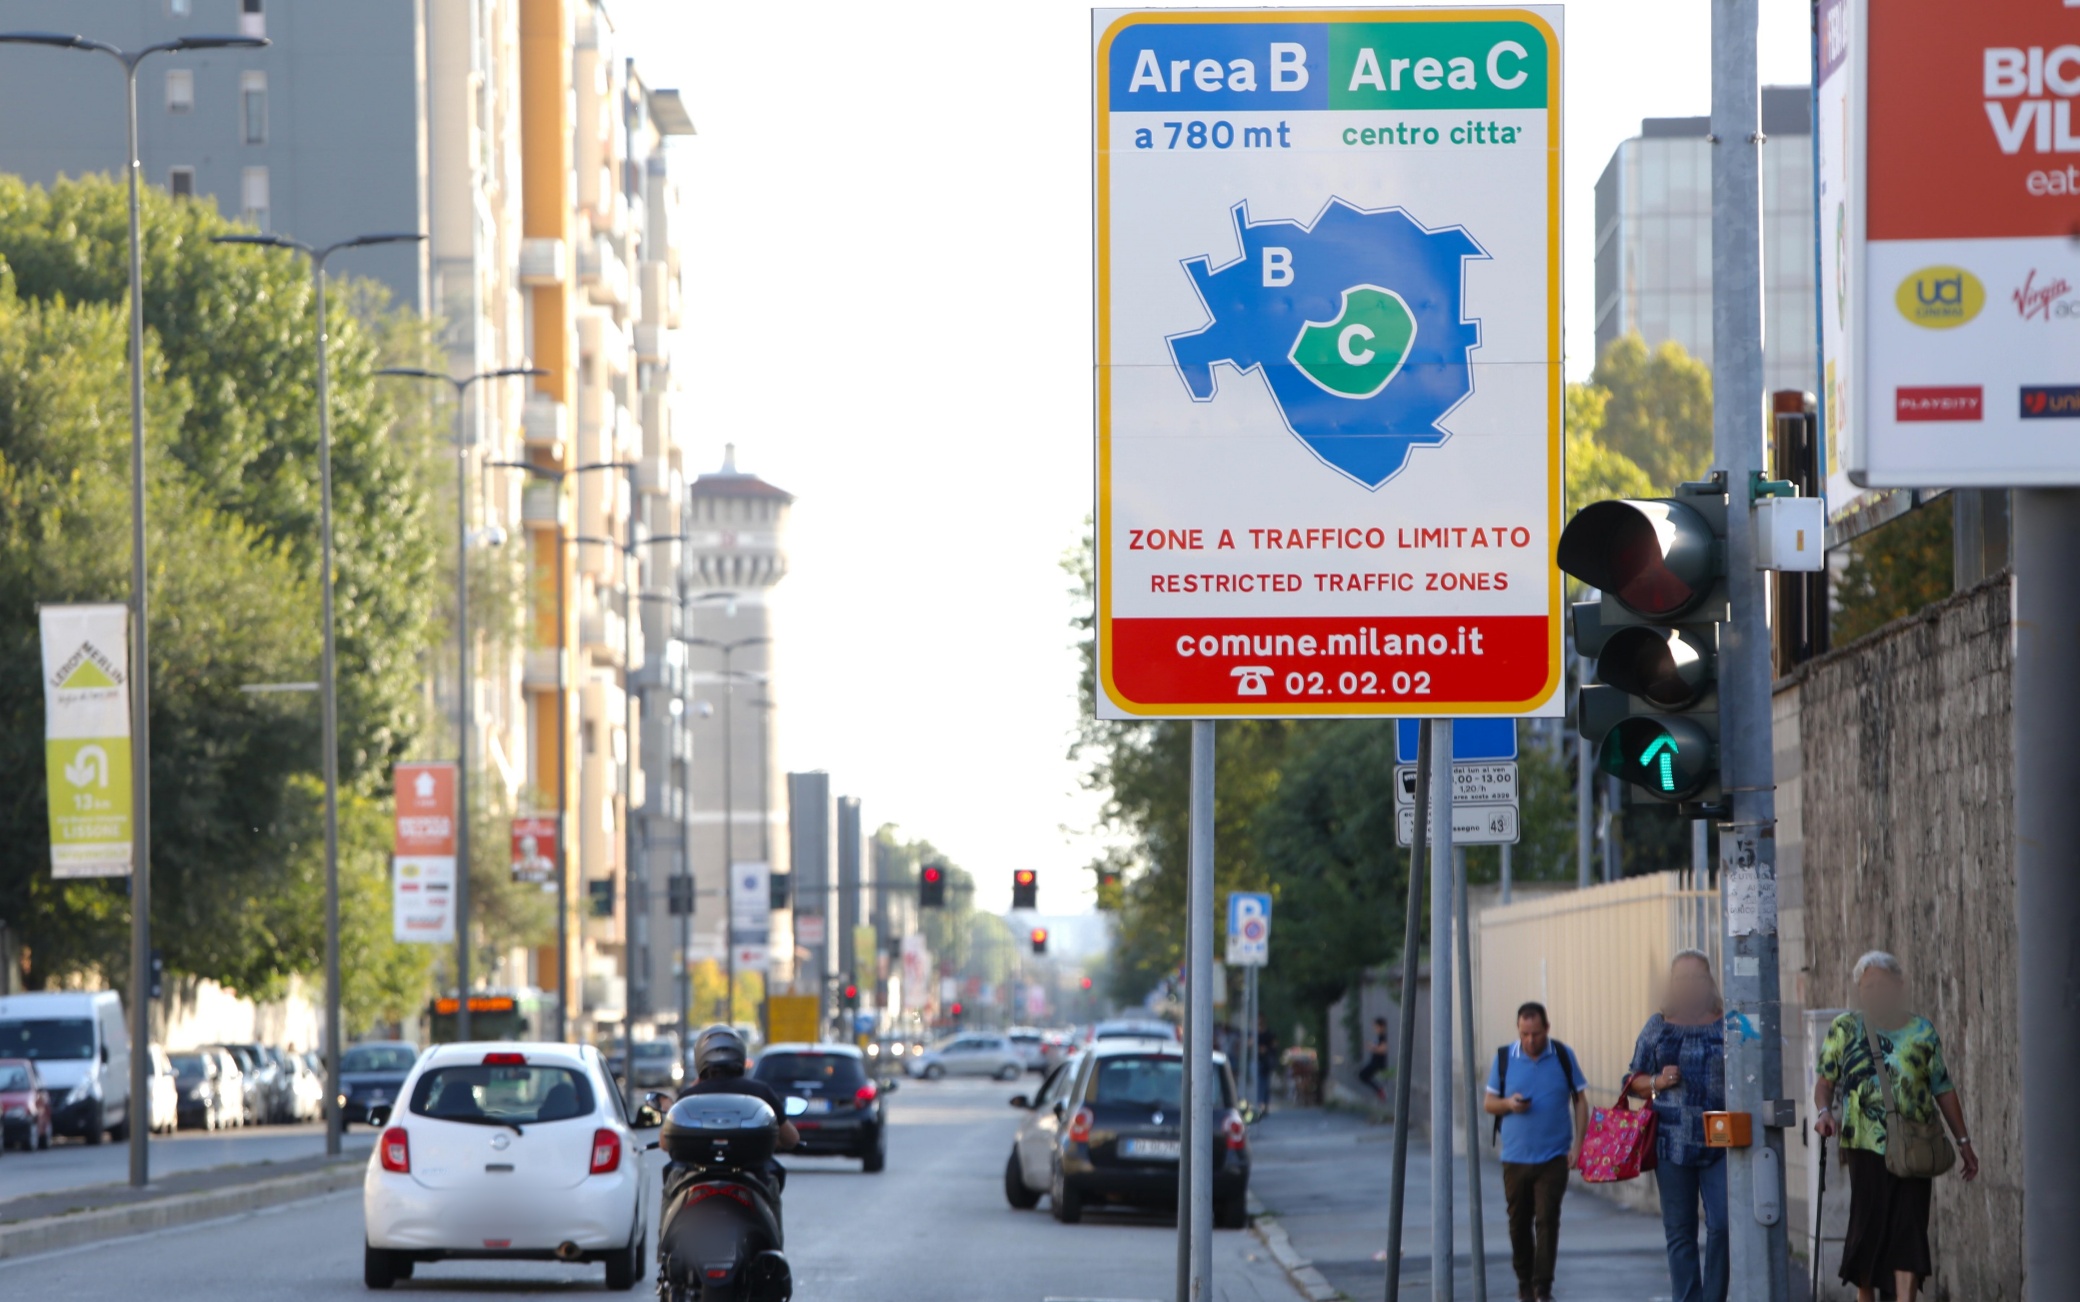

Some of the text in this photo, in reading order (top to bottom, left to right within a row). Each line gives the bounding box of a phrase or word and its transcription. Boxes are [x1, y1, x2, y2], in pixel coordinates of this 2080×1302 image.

[1129, 42, 1310, 92] Area B
[1347, 40, 1529, 92] Area C
[1135, 120, 1291, 150] a 780 mt
[1342, 122, 1440, 145] centro
[1263, 247, 1295, 287] B
[2012, 268, 2072, 321] Virgin
[1337, 323, 1376, 366] C
[1129, 526, 1531, 551] ZONE A TRAFFICO LIMITATO
[1151, 571, 1509, 593] RESTRICTED TRAFFIC ZONES
[1176, 626, 1484, 657] comune.milano.it
[1285, 671, 1431, 695] 02.02.02
[1490, 819, 1505, 833] 43
